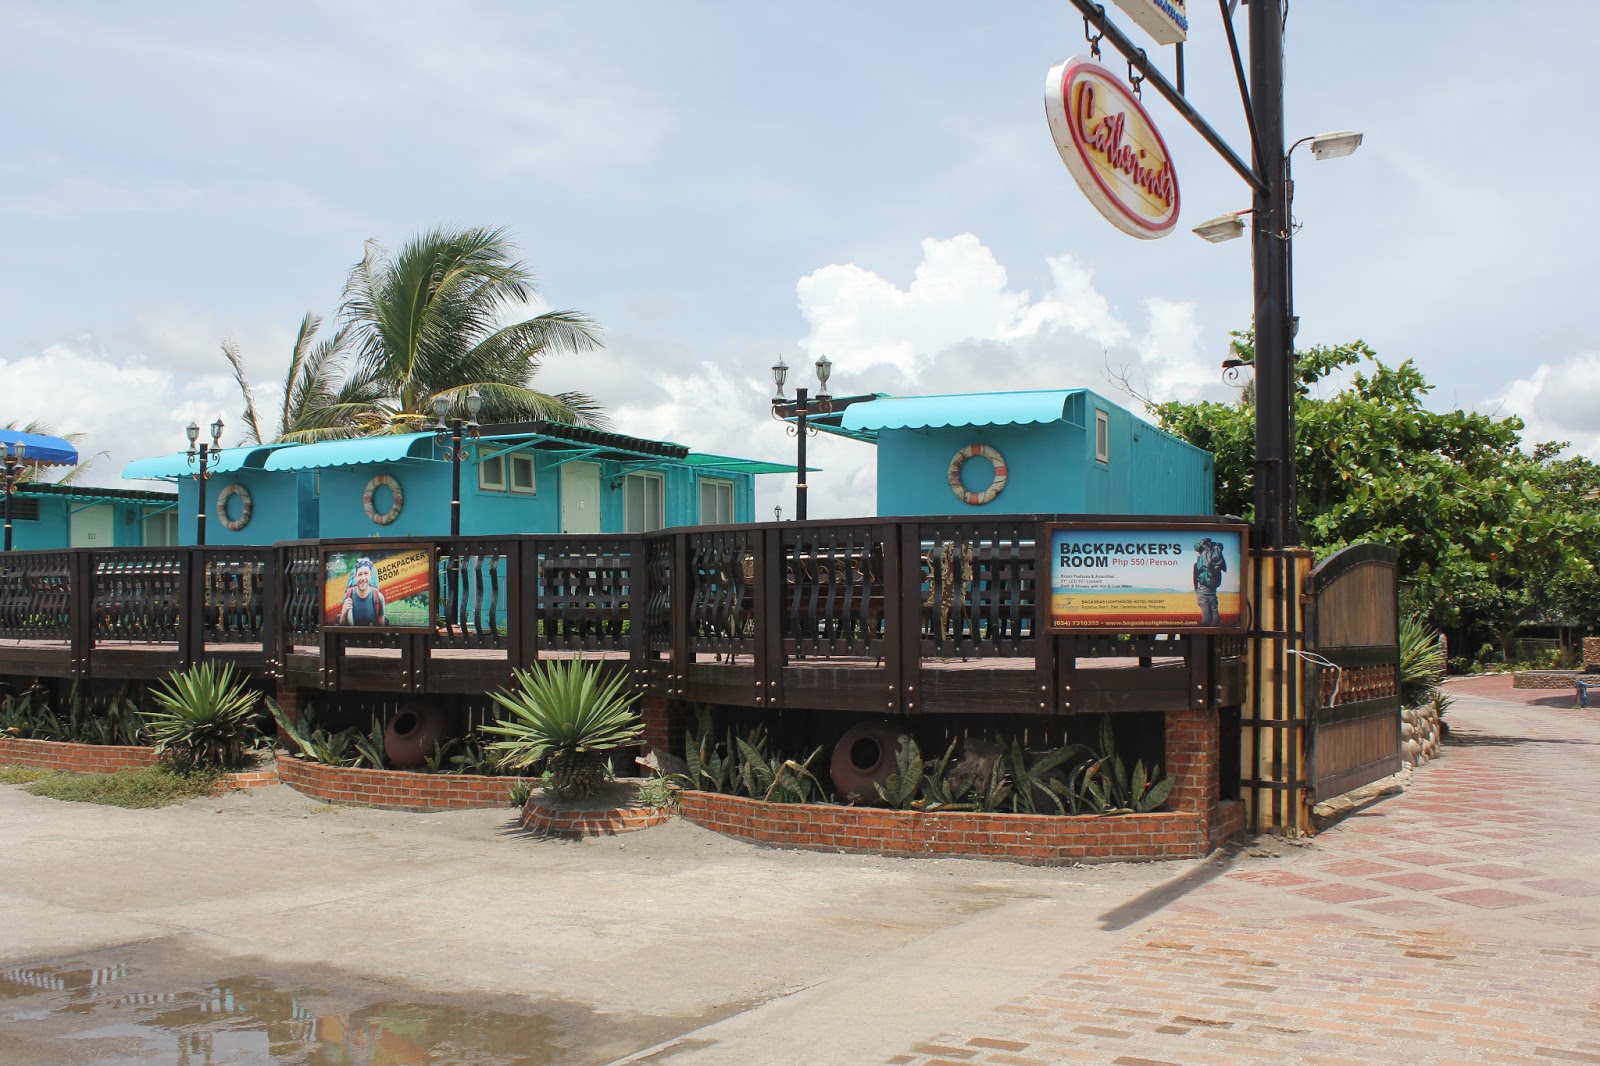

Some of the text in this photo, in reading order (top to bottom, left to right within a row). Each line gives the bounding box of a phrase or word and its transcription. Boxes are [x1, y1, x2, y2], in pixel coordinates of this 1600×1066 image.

[1060, 543, 1182, 555] BACKPACKER'S
[1060, 556, 1108, 568] ROOM
[1112, 558, 1128, 567] Php
[378, 569, 400, 582] ROOM
